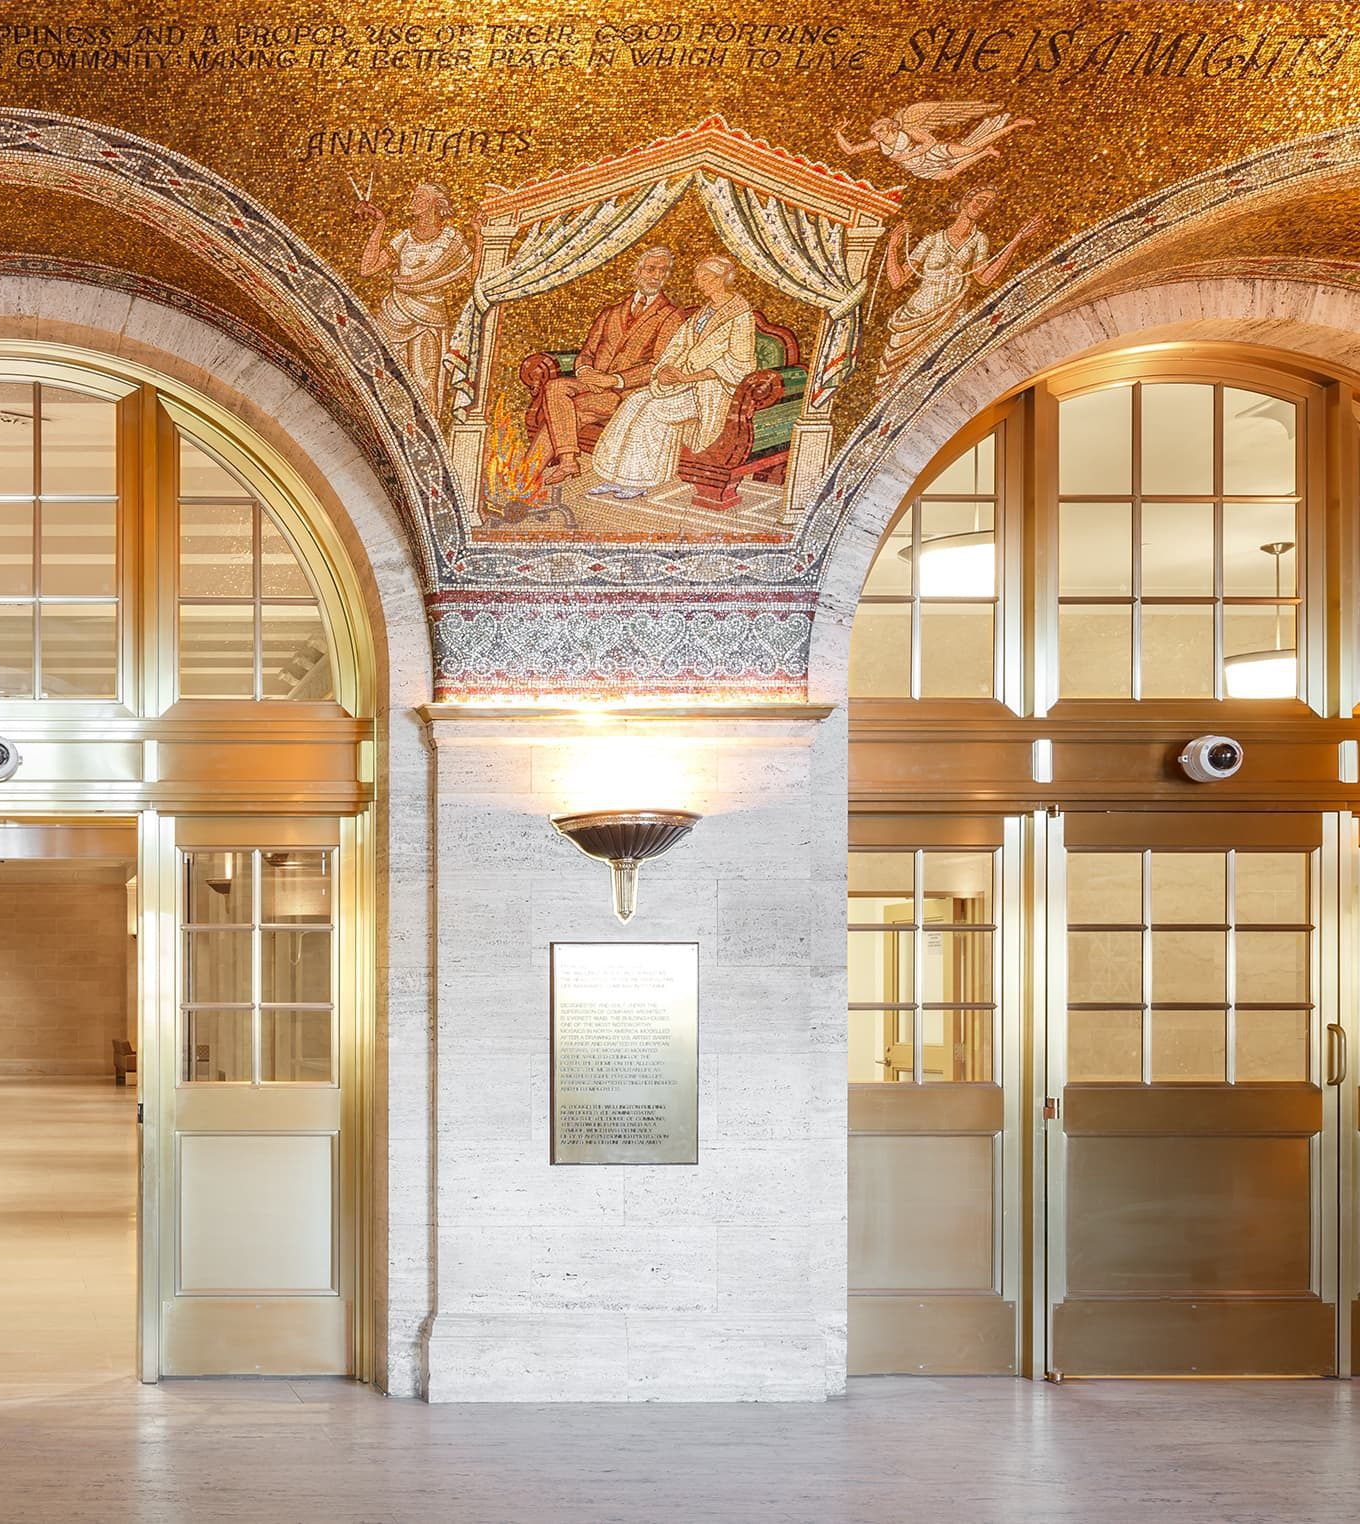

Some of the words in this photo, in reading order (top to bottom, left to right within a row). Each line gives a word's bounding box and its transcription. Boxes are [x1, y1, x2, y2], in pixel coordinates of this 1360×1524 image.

[121, 24, 185, 48] AND
[237, 24, 354, 50] PROPER
[364, 25, 426, 49] USE
[434, 24, 475, 46] OF
[487, 24, 580, 46] THEIR
[595, 24, 684, 47] GOOD
[698, 24, 849, 48] FORTUNE
[190, 49, 298, 72] MAKING
[307, 49, 329, 69] IT
[370, 49, 476, 71] BETTER
[488, 48, 576, 68] PLACE
[588, 49, 617, 68] IN
[628, 48, 729, 68] WHICH
[742, 48, 781, 70] TO
[794, 48, 871, 71] LIVE
[891, 22, 1016, 79] SHE
